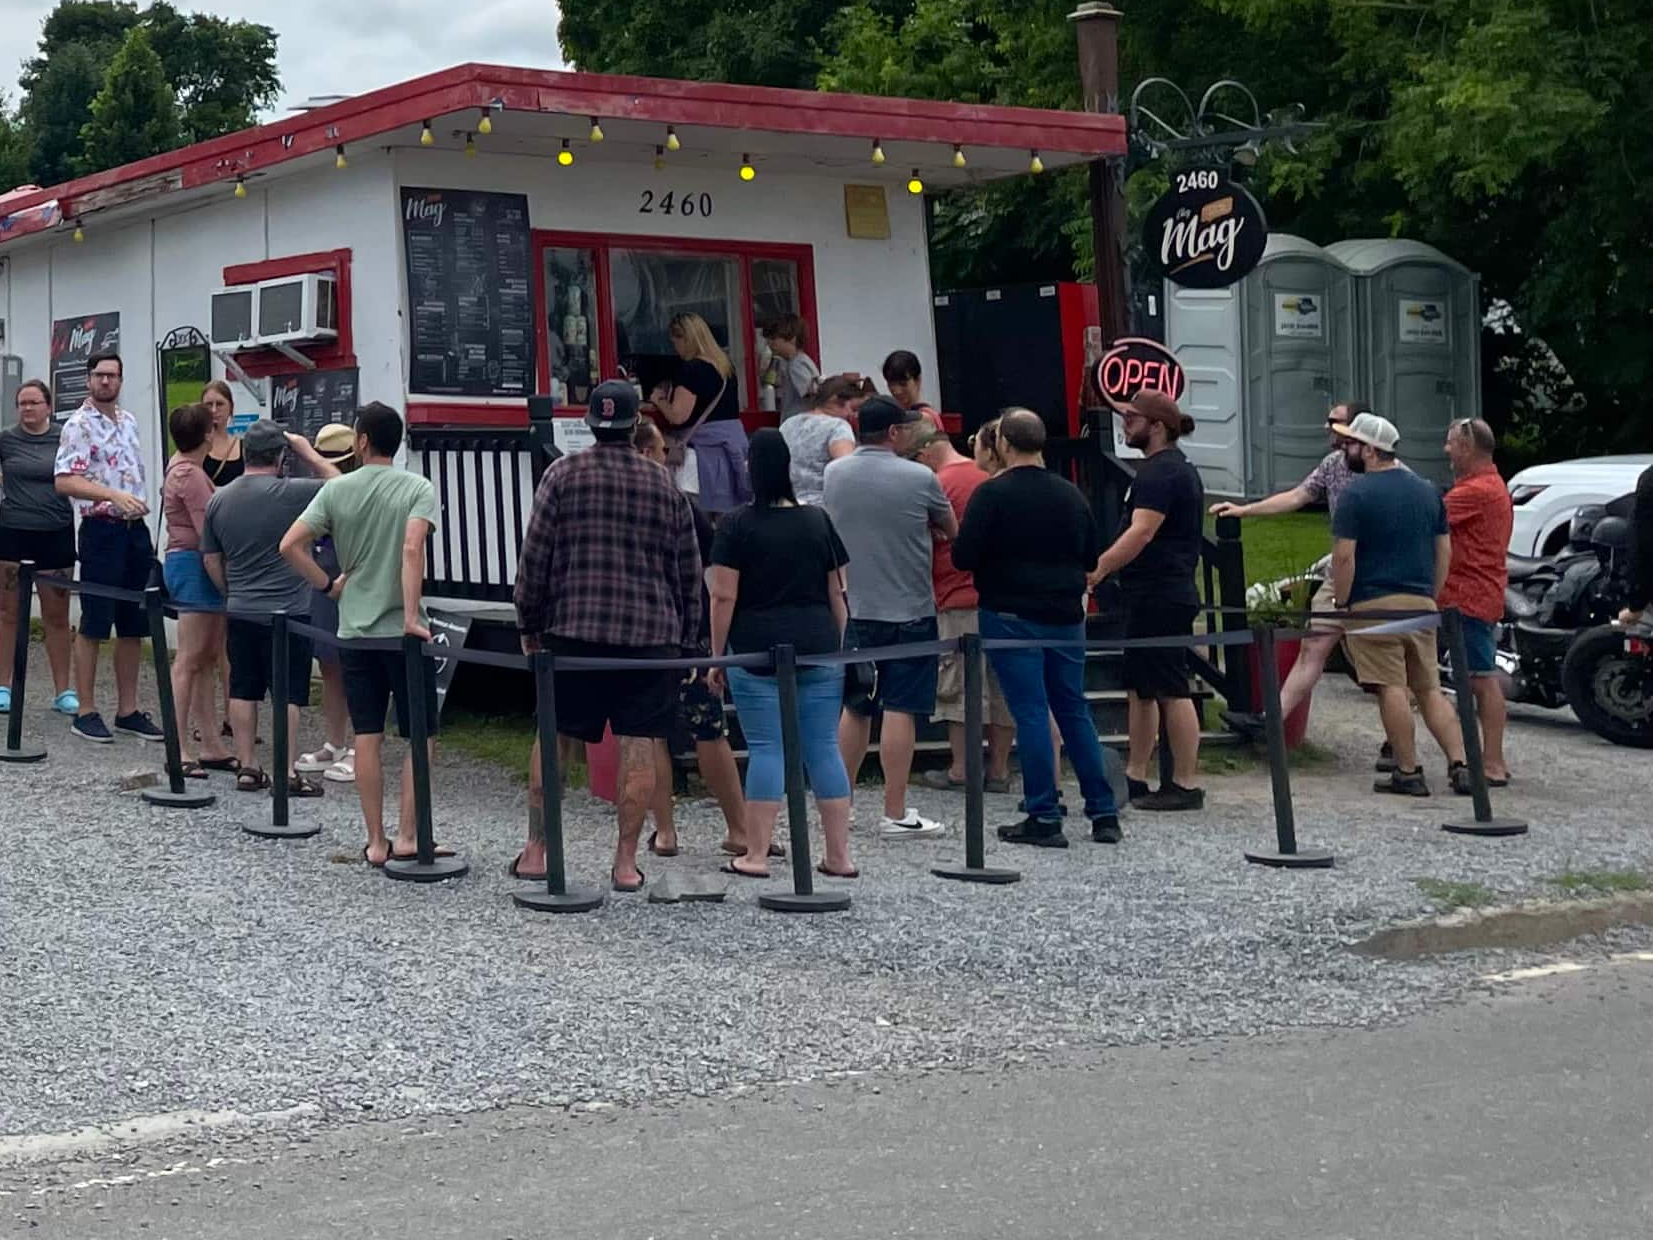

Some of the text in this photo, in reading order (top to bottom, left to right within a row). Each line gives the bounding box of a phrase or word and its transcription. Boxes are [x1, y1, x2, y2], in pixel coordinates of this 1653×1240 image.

[1176, 170, 1219, 194] 2460
[406, 197, 447, 227] Mag
[638, 189, 712, 217] 2460
[1161, 214, 1245, 271] Mag
[1103, 356, 1180, 402] OPEN
